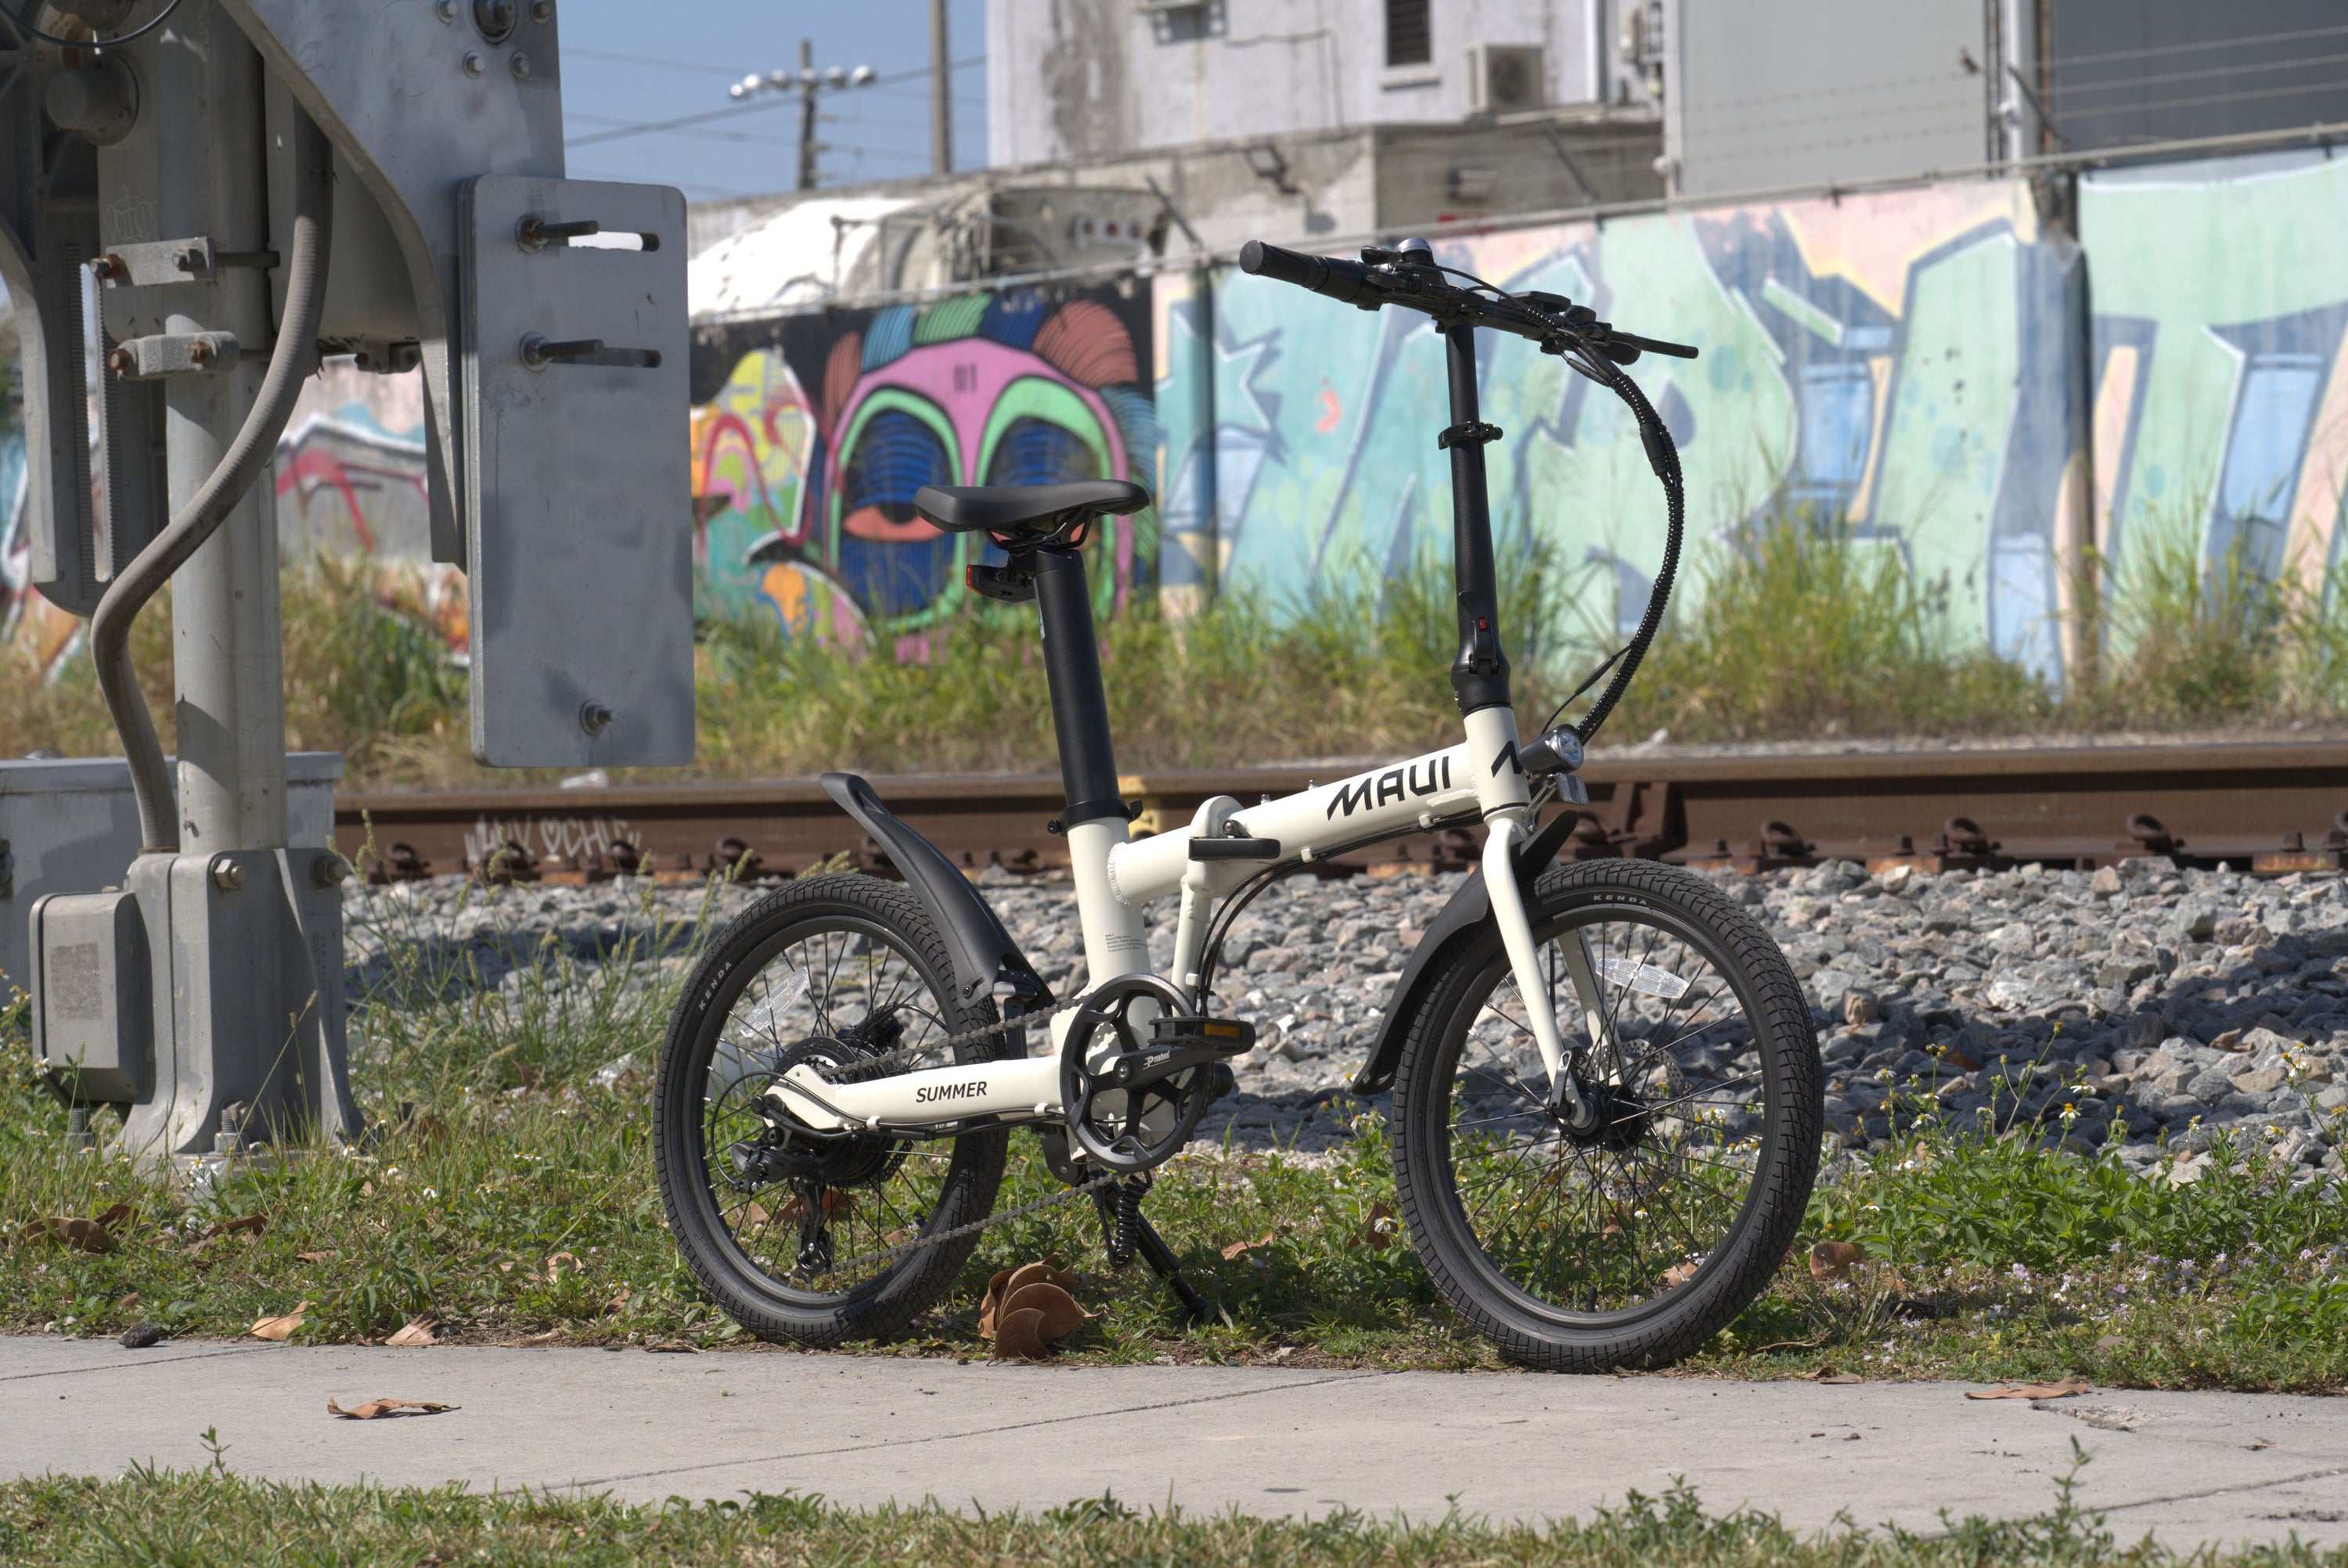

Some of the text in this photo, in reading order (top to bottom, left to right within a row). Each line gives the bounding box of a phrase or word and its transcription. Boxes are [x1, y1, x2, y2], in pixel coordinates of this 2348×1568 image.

[1327, 756, 1451, 822] MAUI
[1593, 894, 1648, 905] KENDA
[699, 962, 732, 1011] KENDA
[916, 1081, 988, 1103] SUMMER
